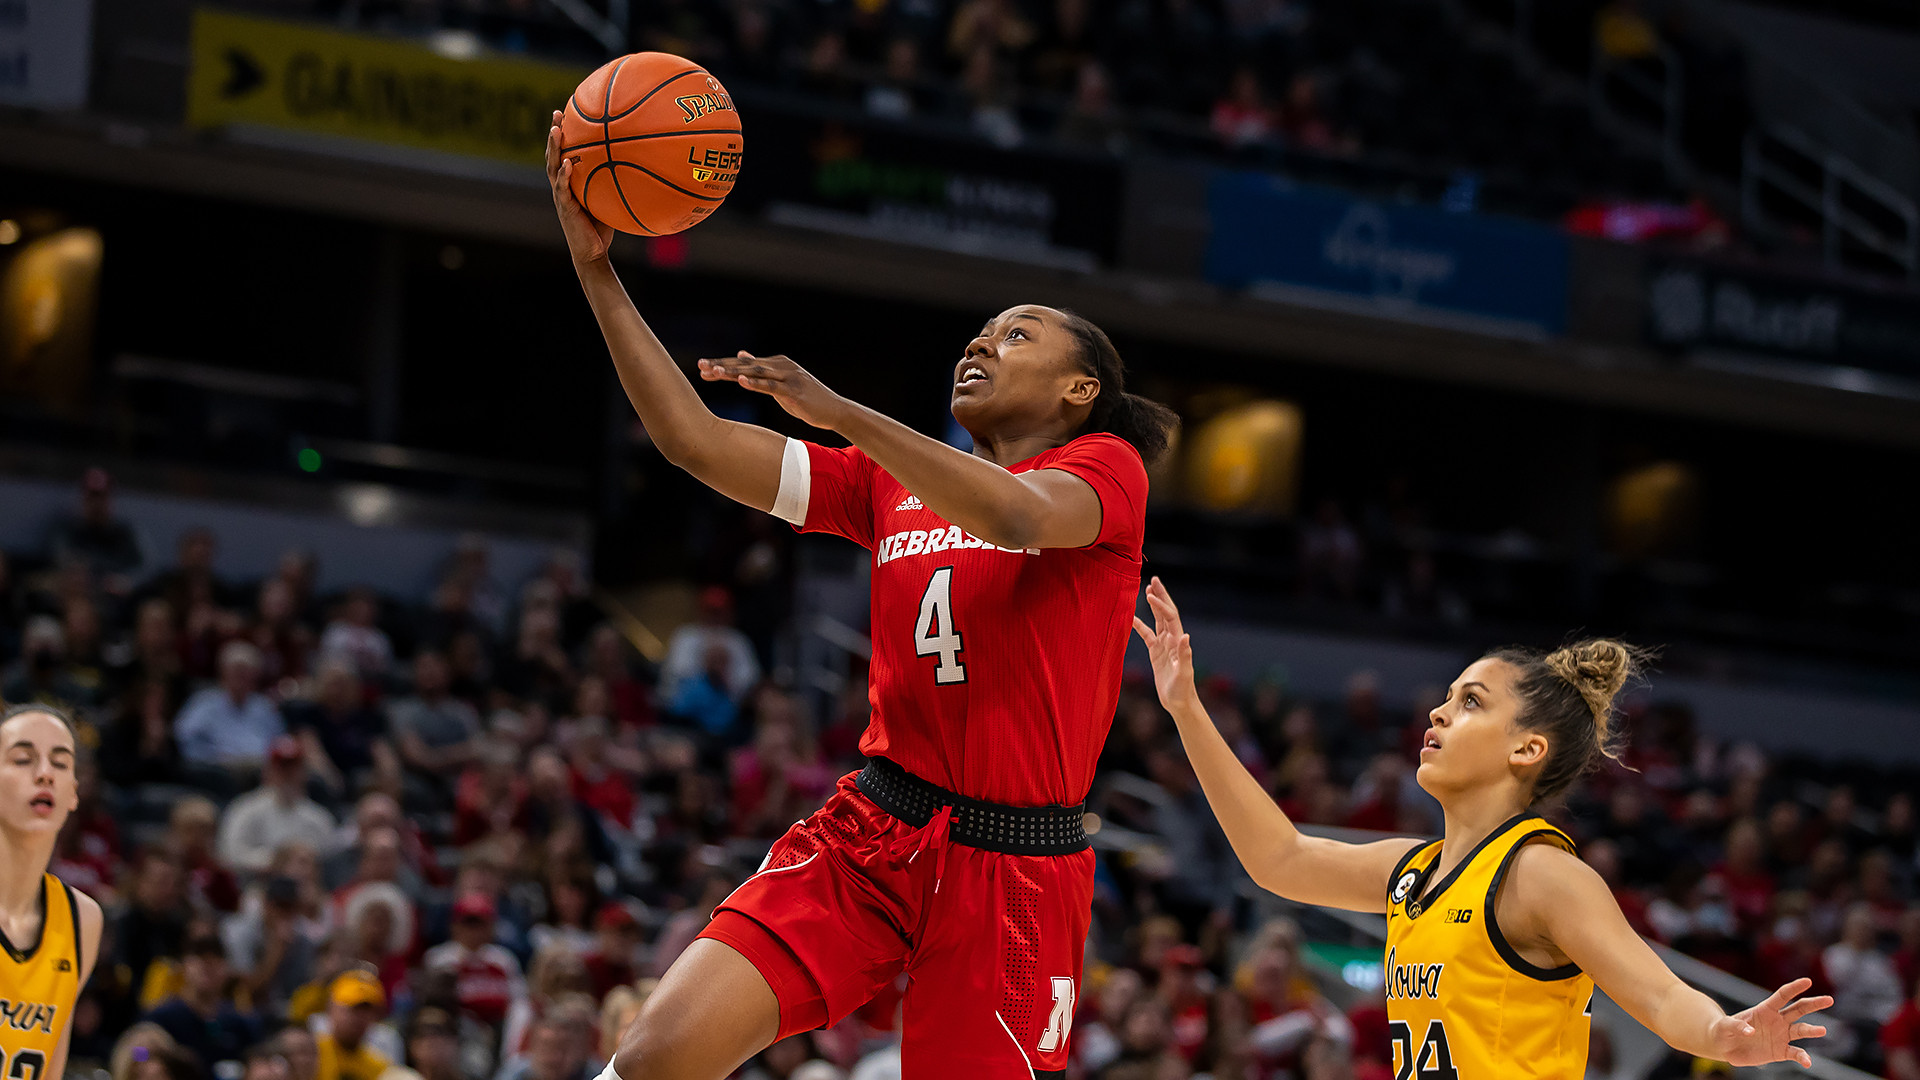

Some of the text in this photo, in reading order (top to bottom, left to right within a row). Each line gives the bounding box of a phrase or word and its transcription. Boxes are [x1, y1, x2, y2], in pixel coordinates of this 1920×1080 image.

[895, 503, 924, 512] adidas
[878, 525, 1041, 568] NEBRAS
[914, 565, 968, 686] 4
[1385, 945, 1445, 1001] Iowa
